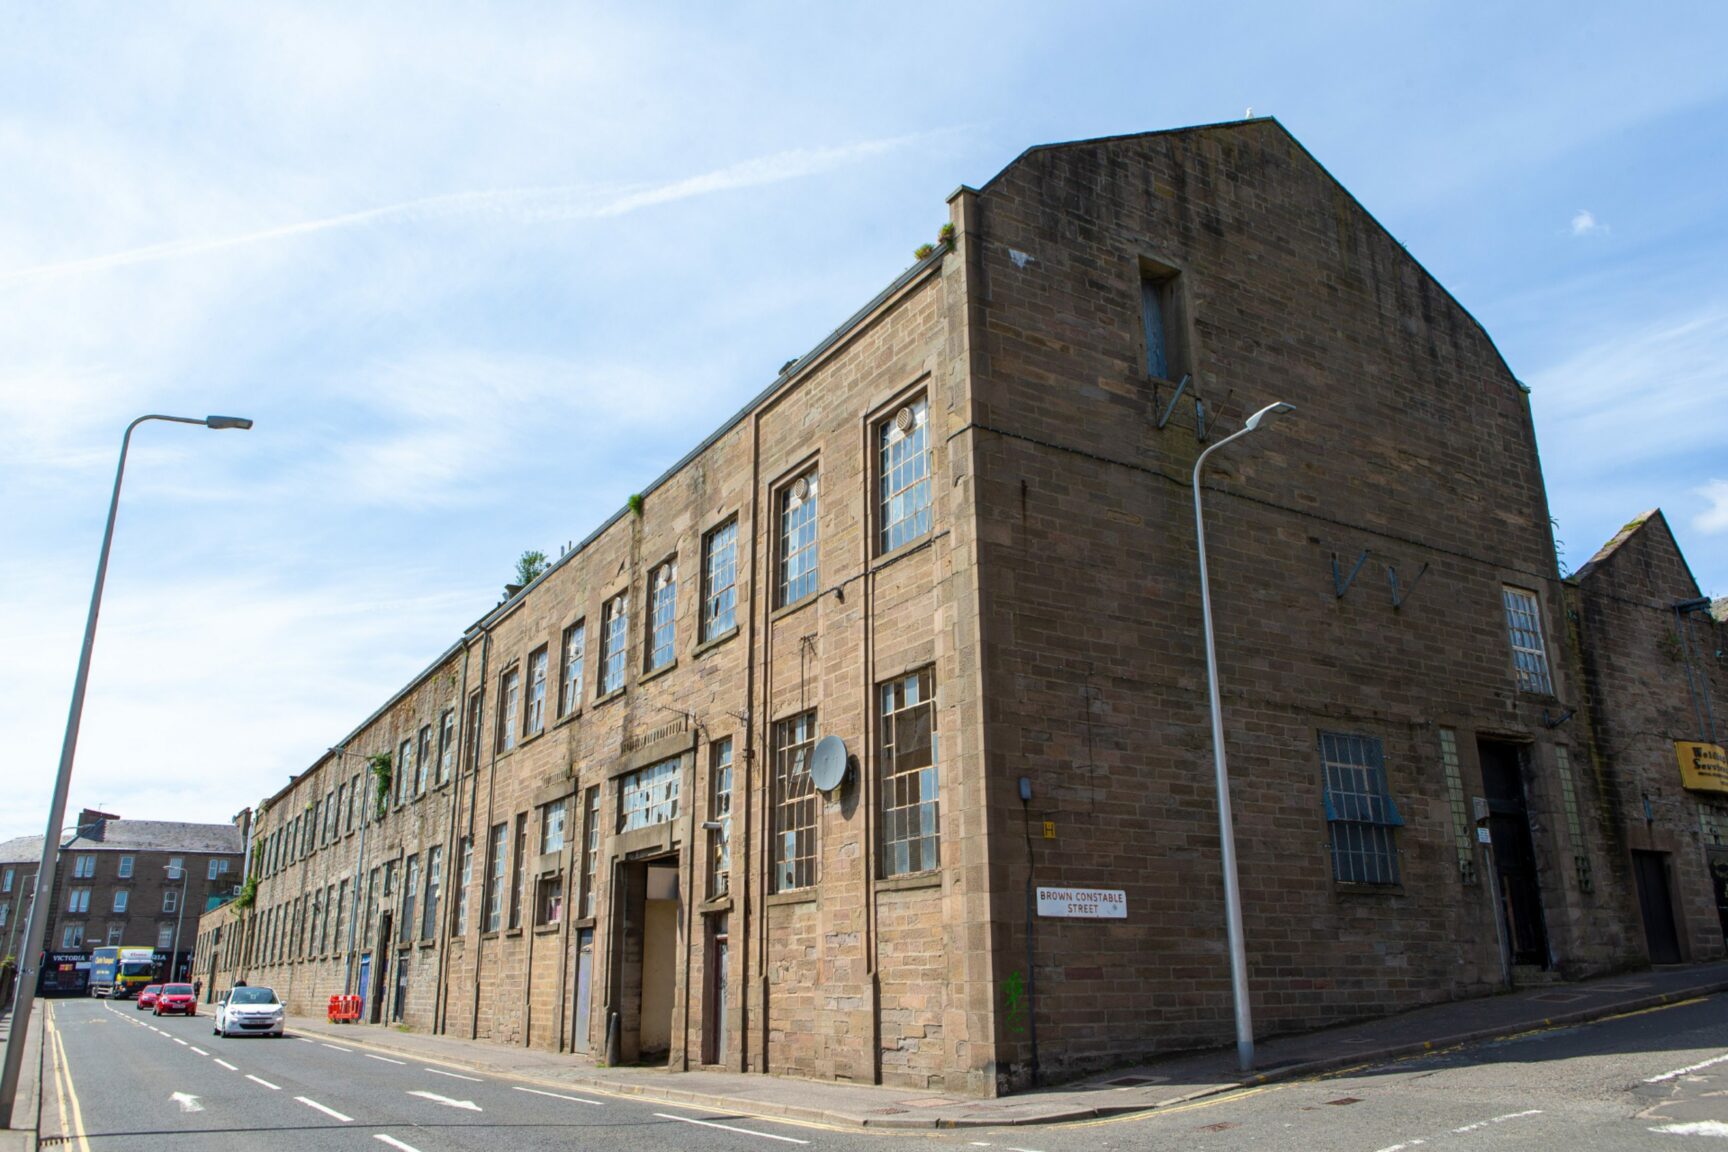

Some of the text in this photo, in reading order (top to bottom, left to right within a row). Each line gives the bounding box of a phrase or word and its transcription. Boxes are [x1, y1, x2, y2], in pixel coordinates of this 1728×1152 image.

[1040, 891, 1123, 903] BROWN CONSTABLE
[1067, 904, 1099, 913] STREET
